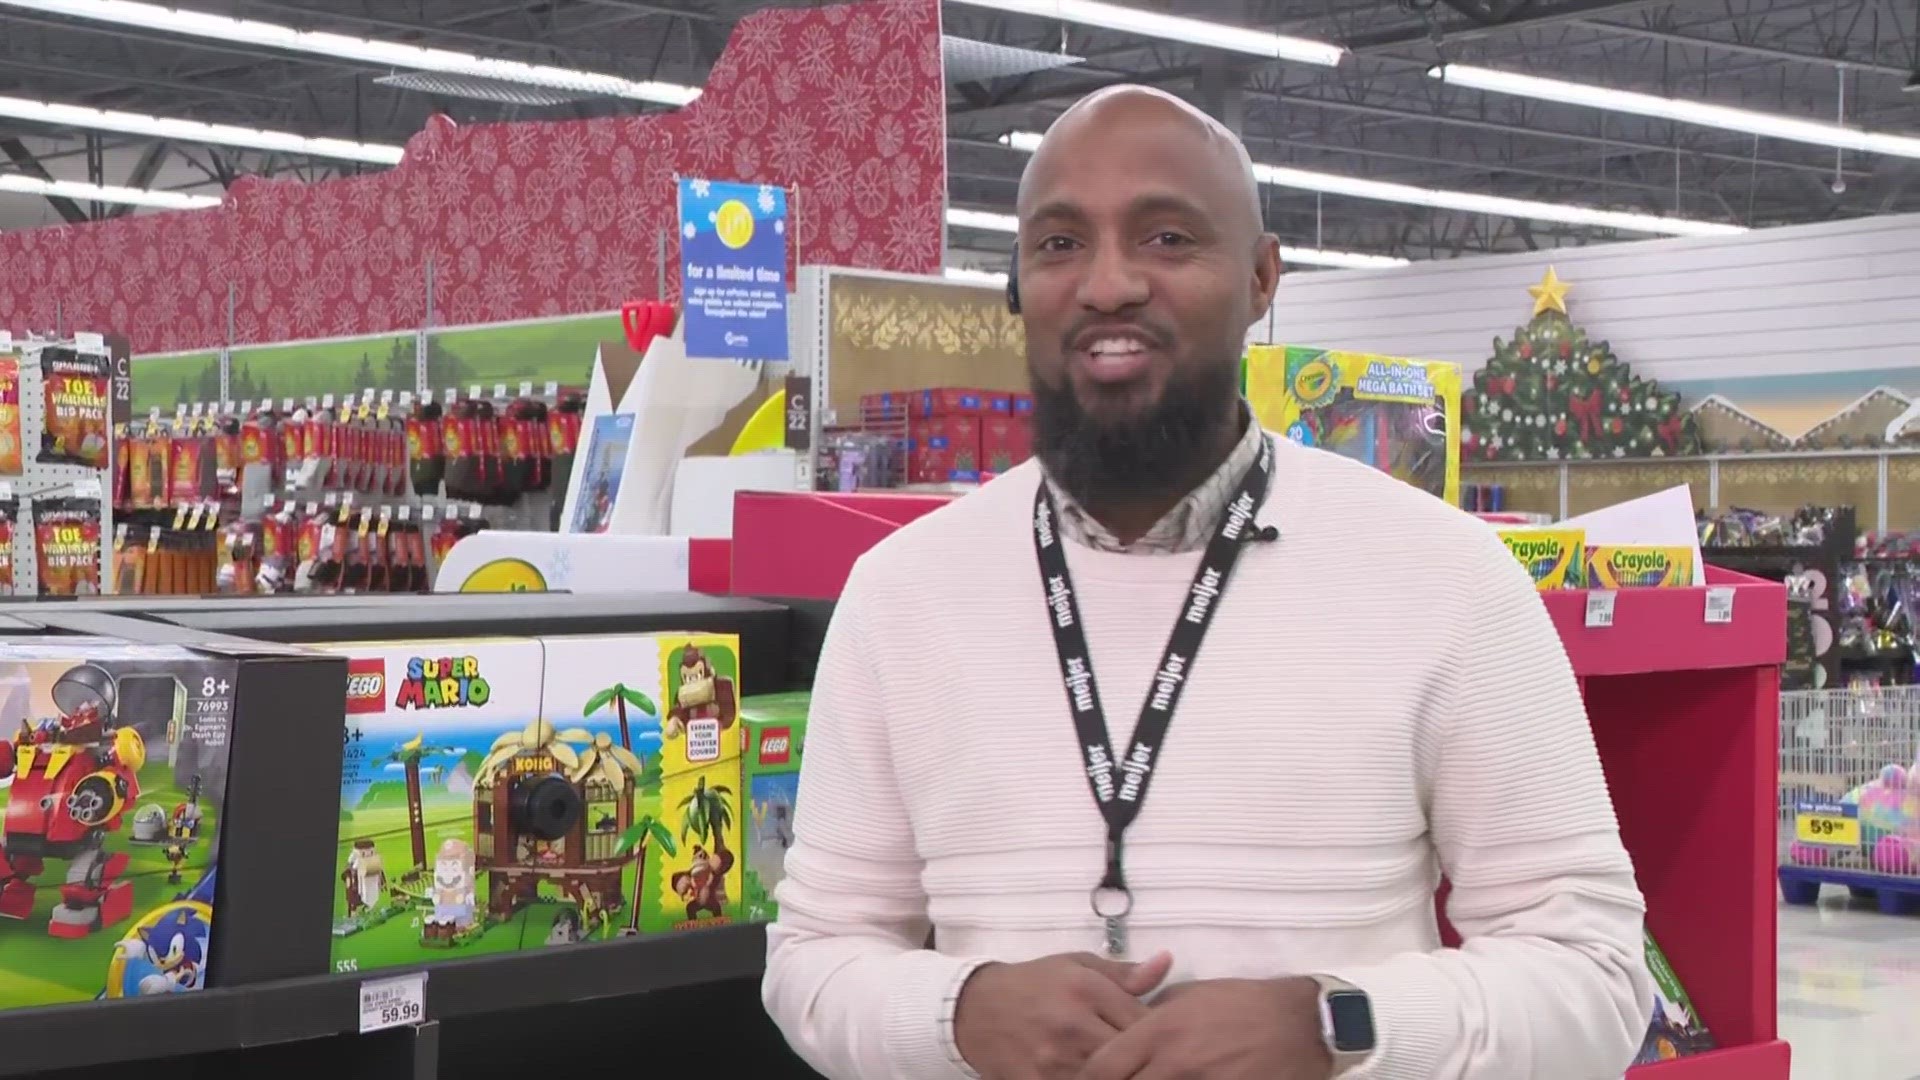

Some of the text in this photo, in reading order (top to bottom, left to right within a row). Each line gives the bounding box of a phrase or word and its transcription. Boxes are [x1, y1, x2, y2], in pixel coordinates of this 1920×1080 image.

[688, 262, 780, 282] for a limited time
[117, 357, 127, 376] C
[1368, 362, 1426, 381] ALL-IN-ONE
[63, 378, 93, 395] TOE
[116, 382, 129, 400] 22
[1357, 378, 1435, 398] MEGA BATH SET
[52, 393, 107, 408] WARMERS
[791, 394, 804, 409] C
[56, 406, 103, 419] BIG PACK
[788, 413, 806, 431] 22
[1222, 491, 1255, 541] meijer
[53, 527, 83, 543] TOE
[48, 555, 93, 567] BIG PACK
[1613, 550, 1665, 572] Crayola
[1048, 573, 1074, 628] meijer
[1186, 566, 1222, 624] meijer
[407, 655, 479, 681] SUPER
[202, 676, 230, 697] 8+
[346, 675, 383, 698] EGO
[1065, 656, 1095, 712] meijer
[1151, 652, 1187, 711] meijer
[396, 678, 490, 711] MARIO
[197, 701, 228, 712] 76993
[690, 723, 716, 732] EXPAND
[689, 740, 717, 748] STARTER
[689, 748, 717, 757] COURSE
[761, 738, 789, 755] LEGO
[516, 757, 553, 771] KONG
[1087, 744, 1115, 803] meijer
[1117, 742, 1153, 802] meijer
[1810, 819, 1833, 835] 59
[382, 1003, 419, 1024] 59.99
